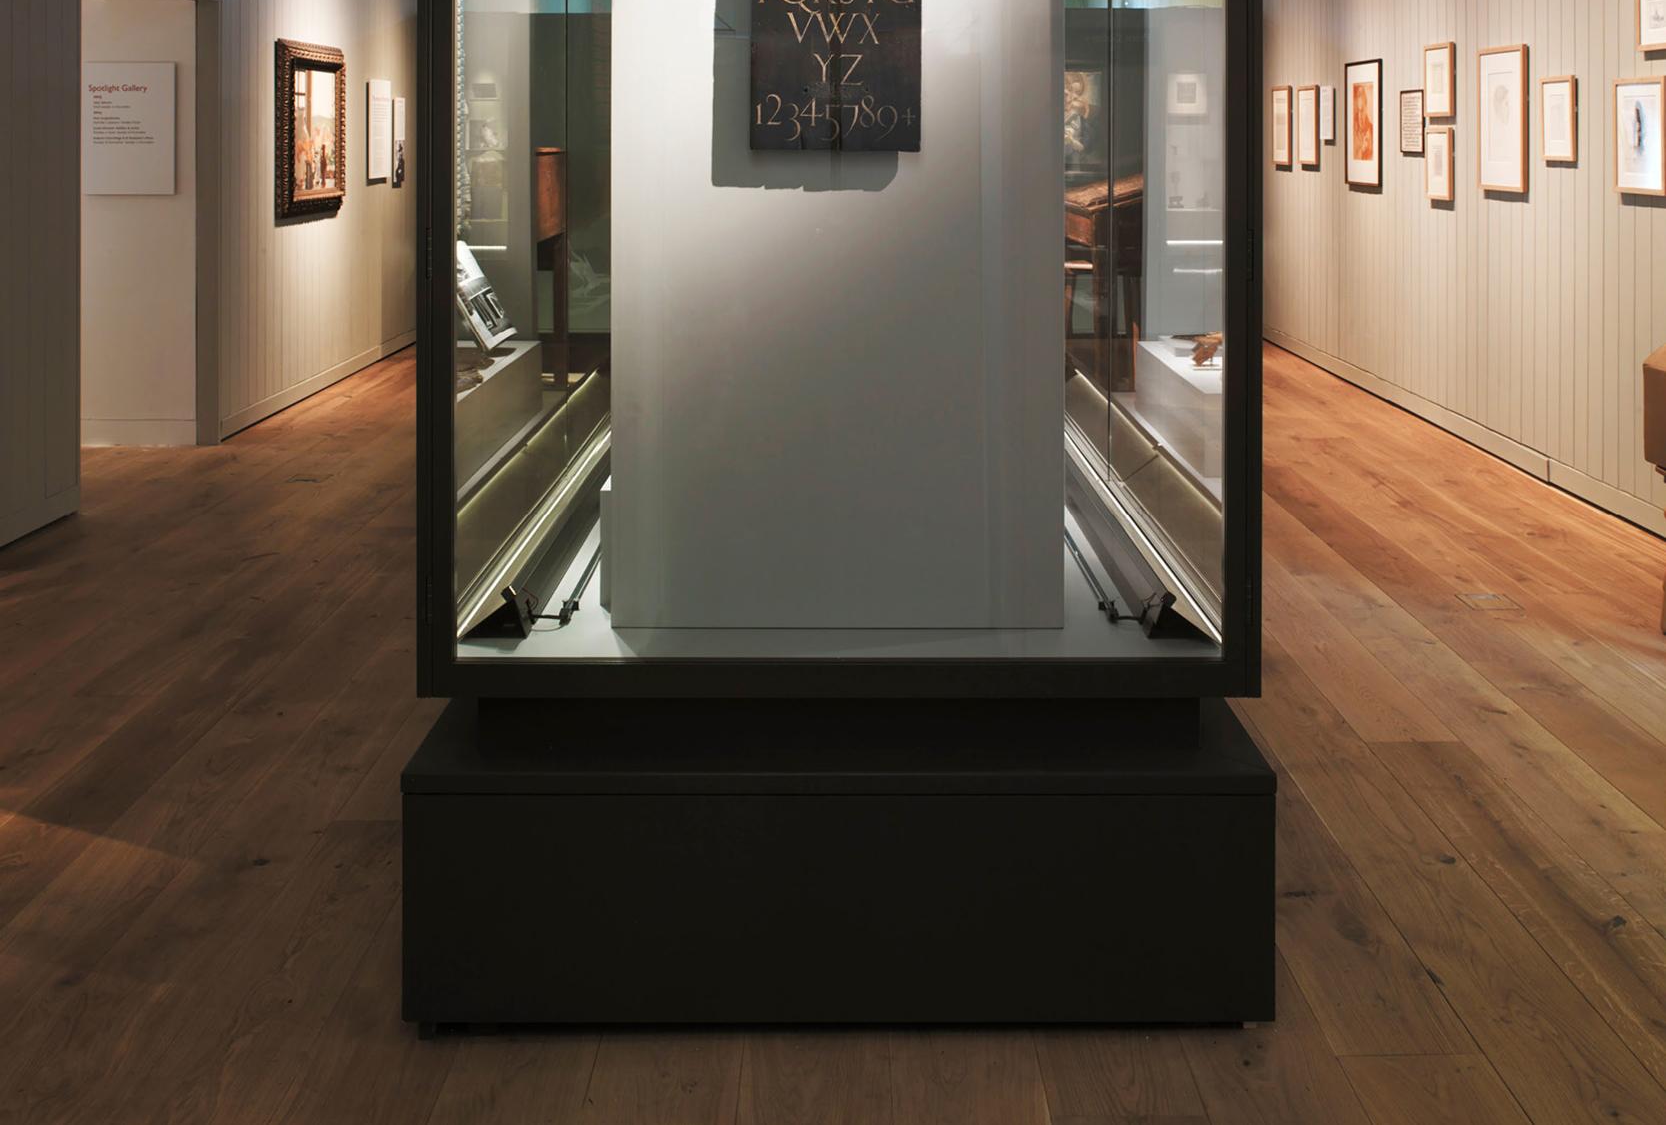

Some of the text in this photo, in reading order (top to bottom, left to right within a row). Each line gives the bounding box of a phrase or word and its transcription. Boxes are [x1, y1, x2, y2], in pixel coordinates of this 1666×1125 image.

[786, 11, 881, 45] VWX
[88, 84, 148, 93] Spotlight Gallery
